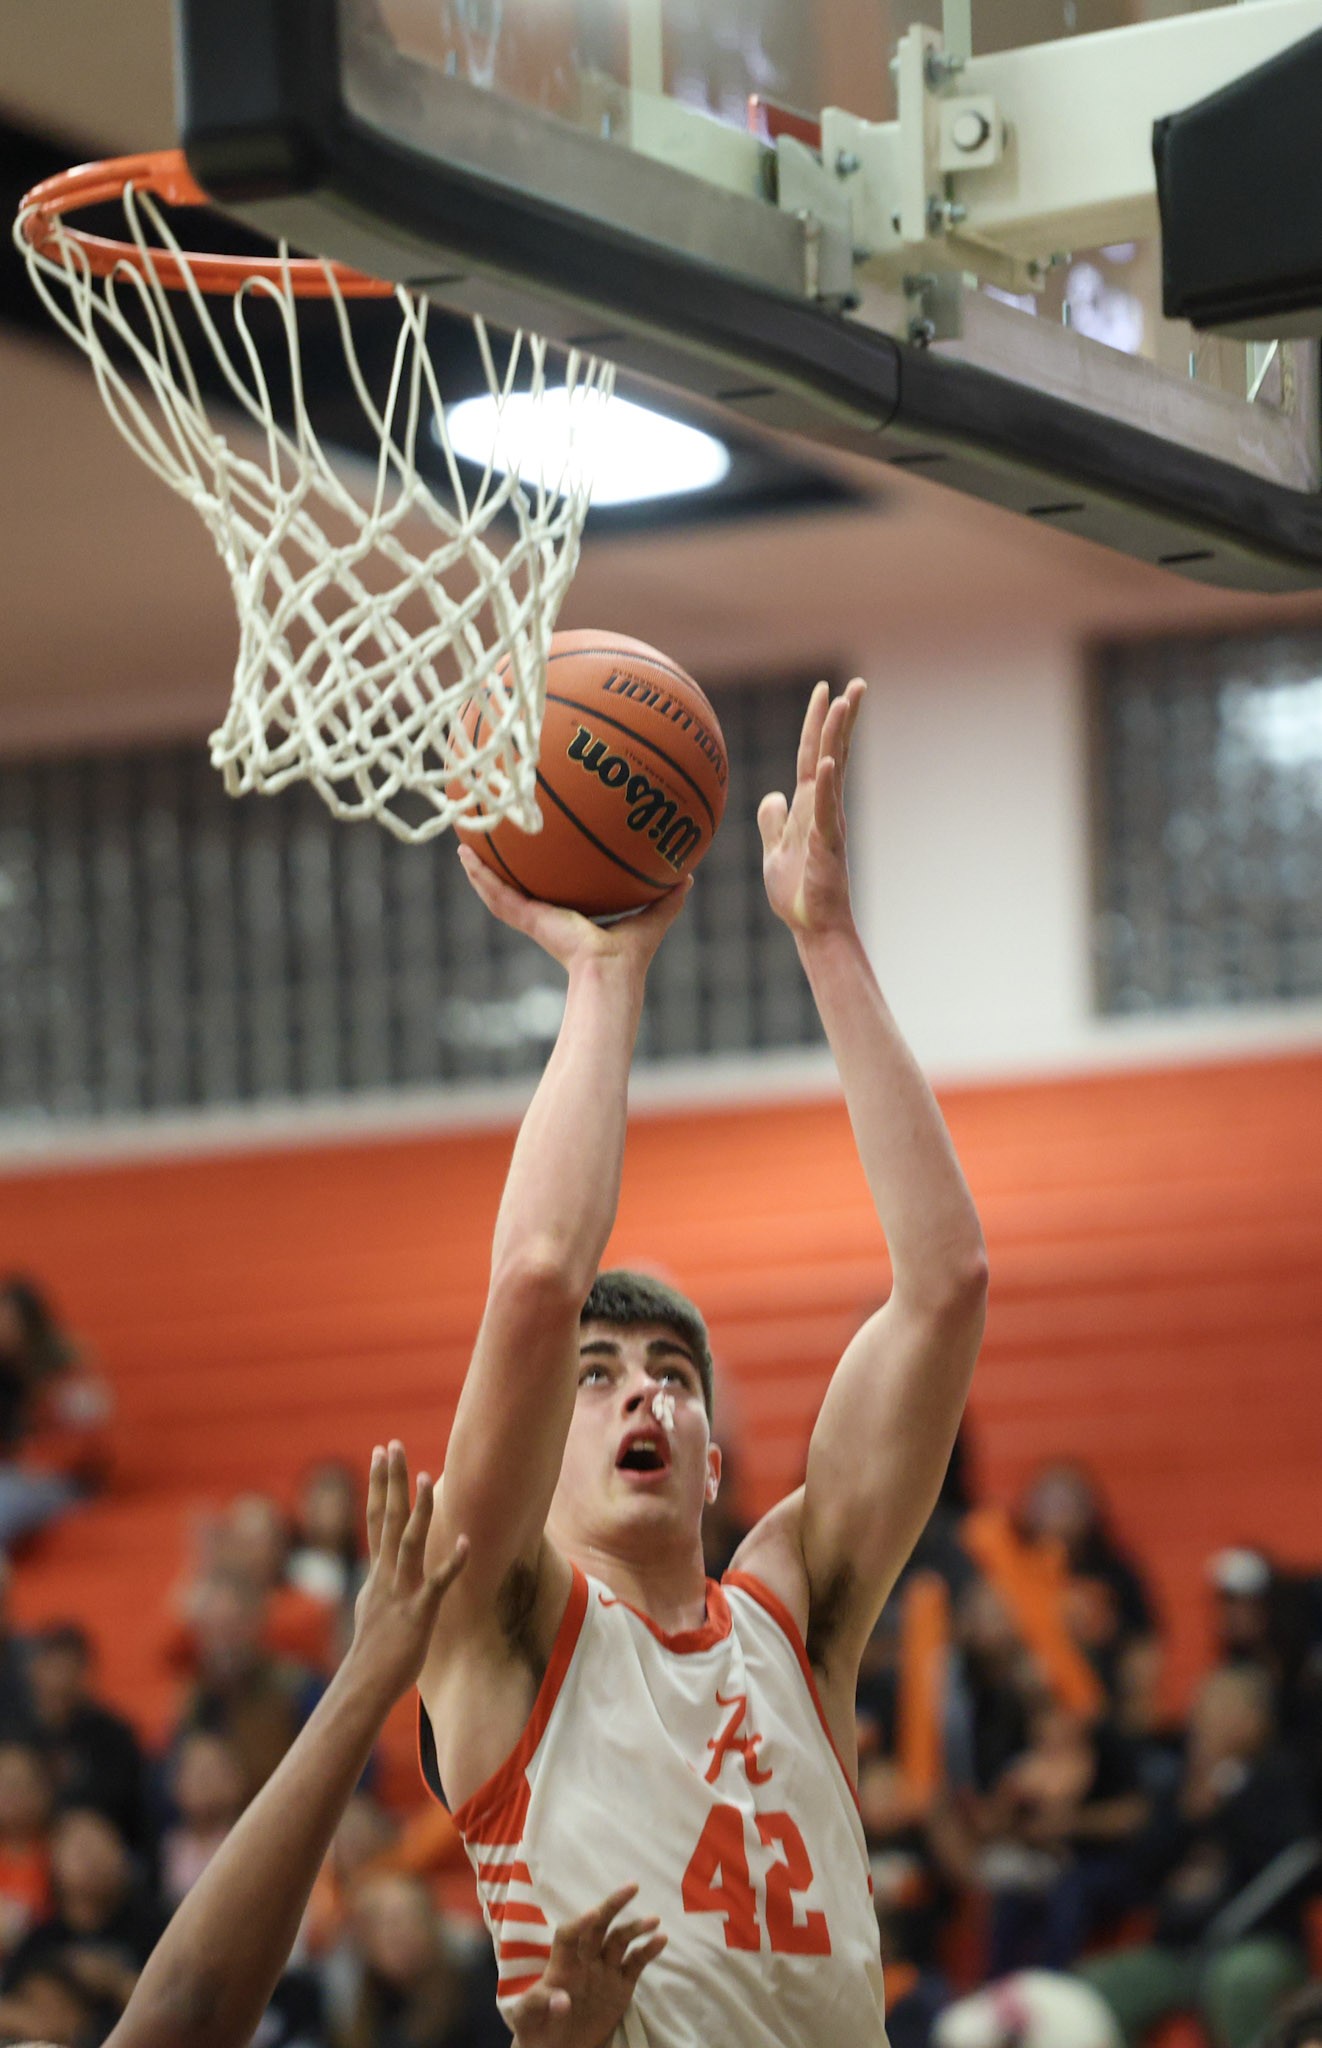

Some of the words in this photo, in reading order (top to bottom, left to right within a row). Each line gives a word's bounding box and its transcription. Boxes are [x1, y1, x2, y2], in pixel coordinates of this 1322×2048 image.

[567, 725, 702, 872] Wilson
[705, 1689, 773, 1785] A
[681, 1803, 832, 1956] 42
